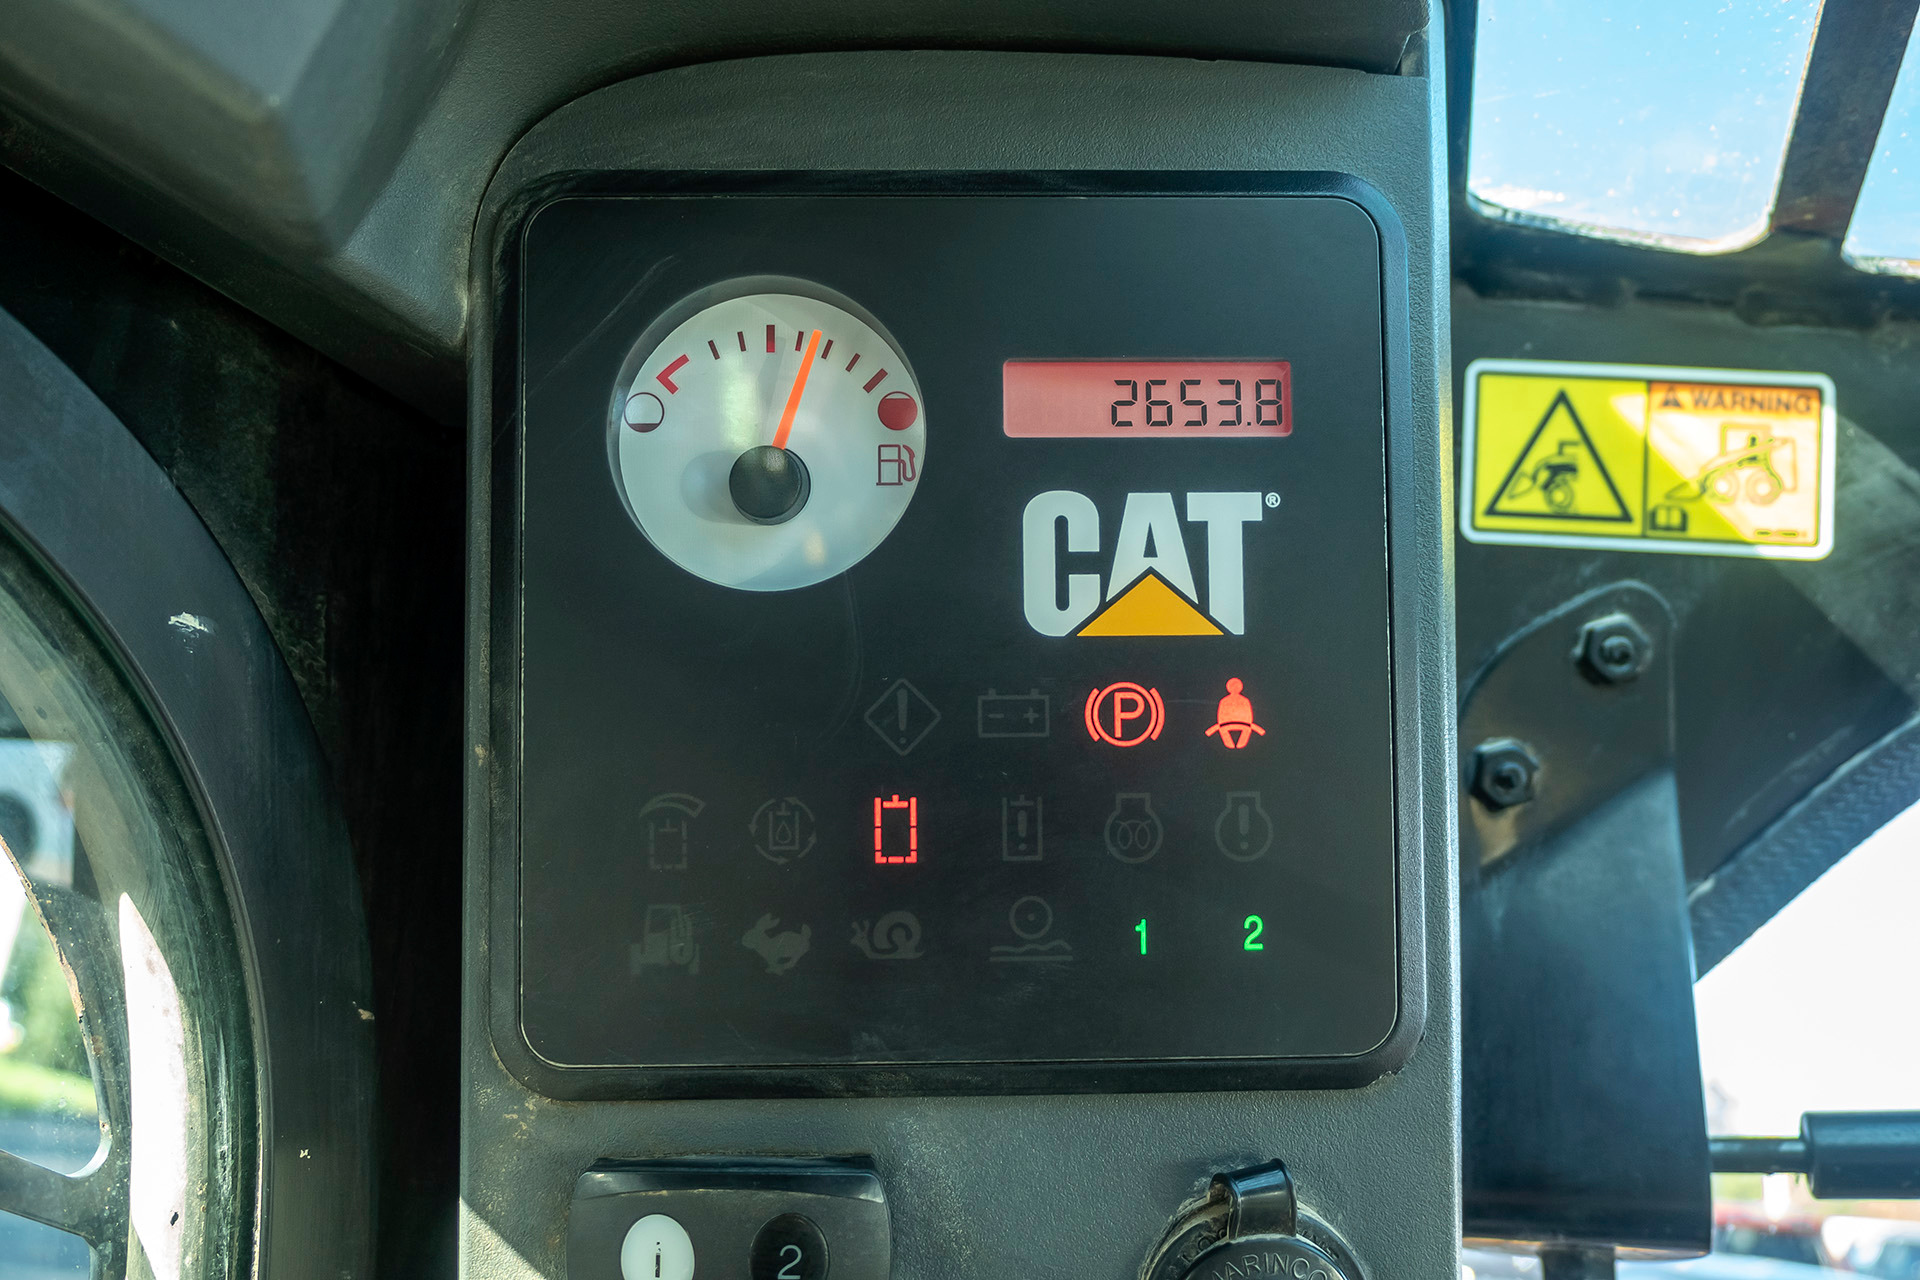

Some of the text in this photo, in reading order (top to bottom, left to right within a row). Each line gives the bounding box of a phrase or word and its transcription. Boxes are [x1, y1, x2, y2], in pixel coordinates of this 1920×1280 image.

[1111, 379, 1283, 427] 2653.8
[1690, 387, 1811, 414] WARNING
[1135, 918, 1148, 955] 1
[1243, 914, 1265, 951] 2
[777, 1244, 802, 1280] 2
